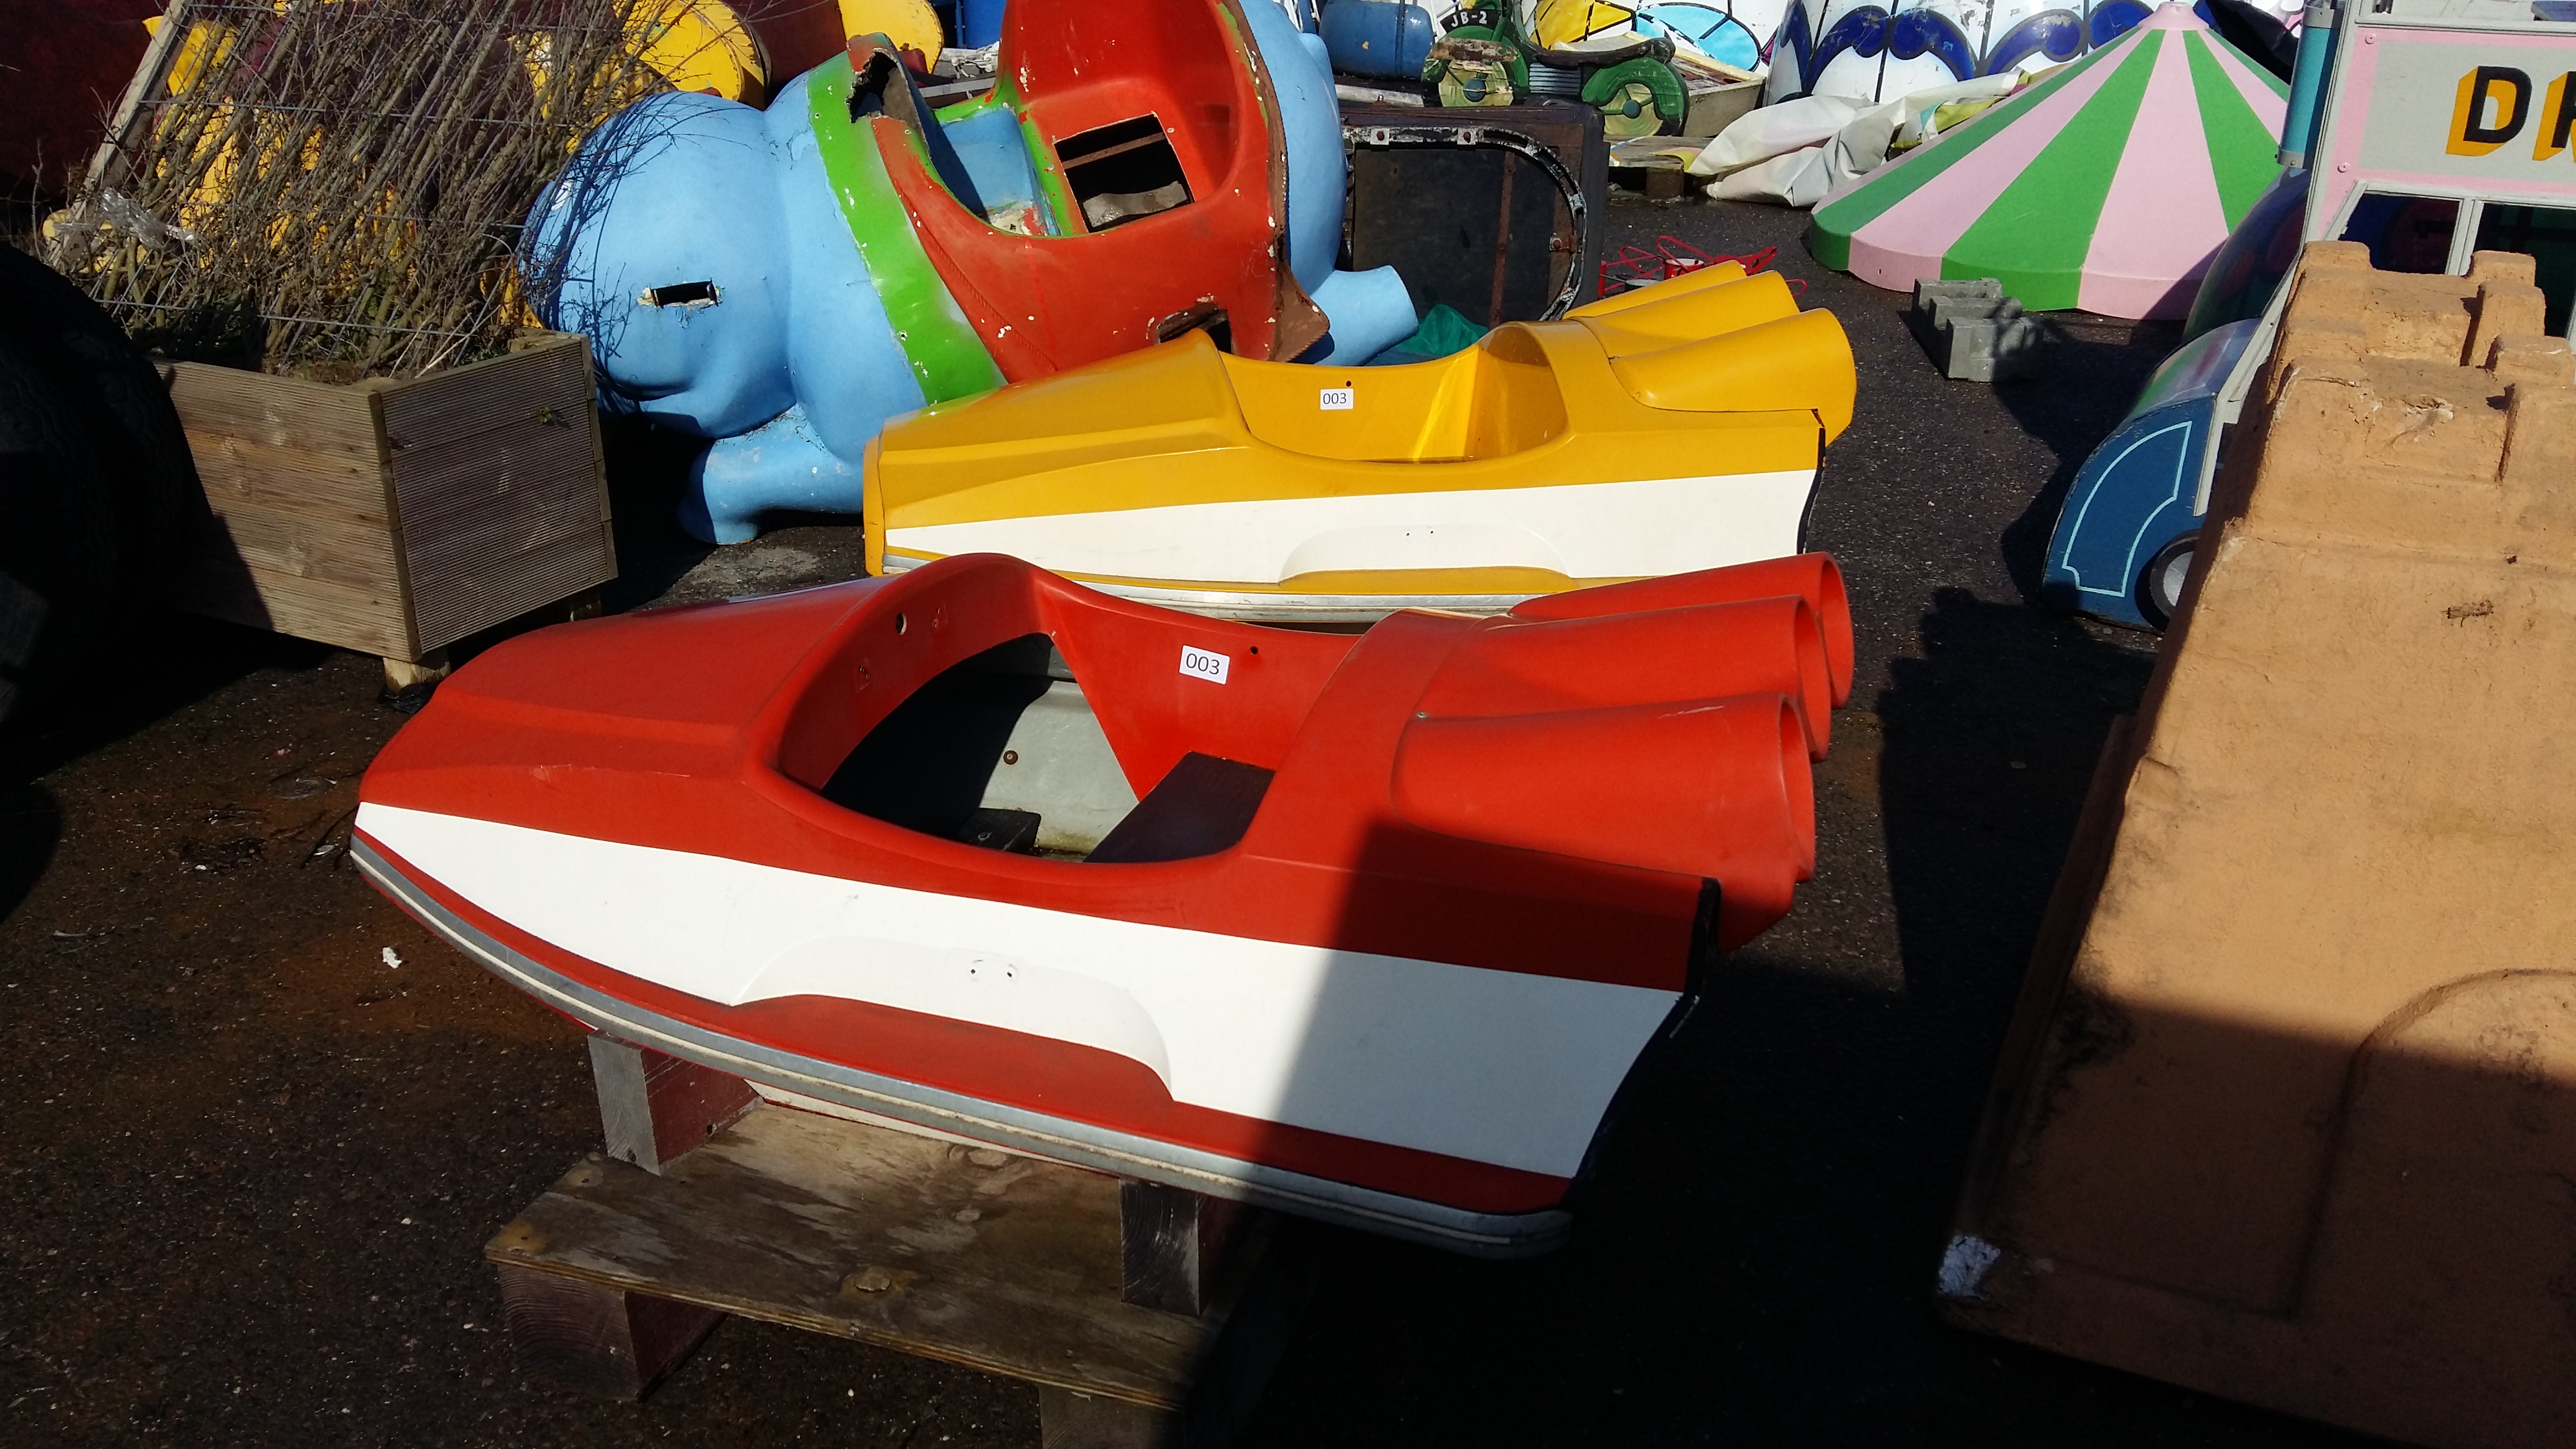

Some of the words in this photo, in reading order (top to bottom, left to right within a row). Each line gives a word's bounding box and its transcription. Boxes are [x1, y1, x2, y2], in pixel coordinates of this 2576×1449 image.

[1451, 10, 1488, 27] JB-2
[1322, 393, 1347, 405] 003
[1186, 653, 1220, 675] 003
